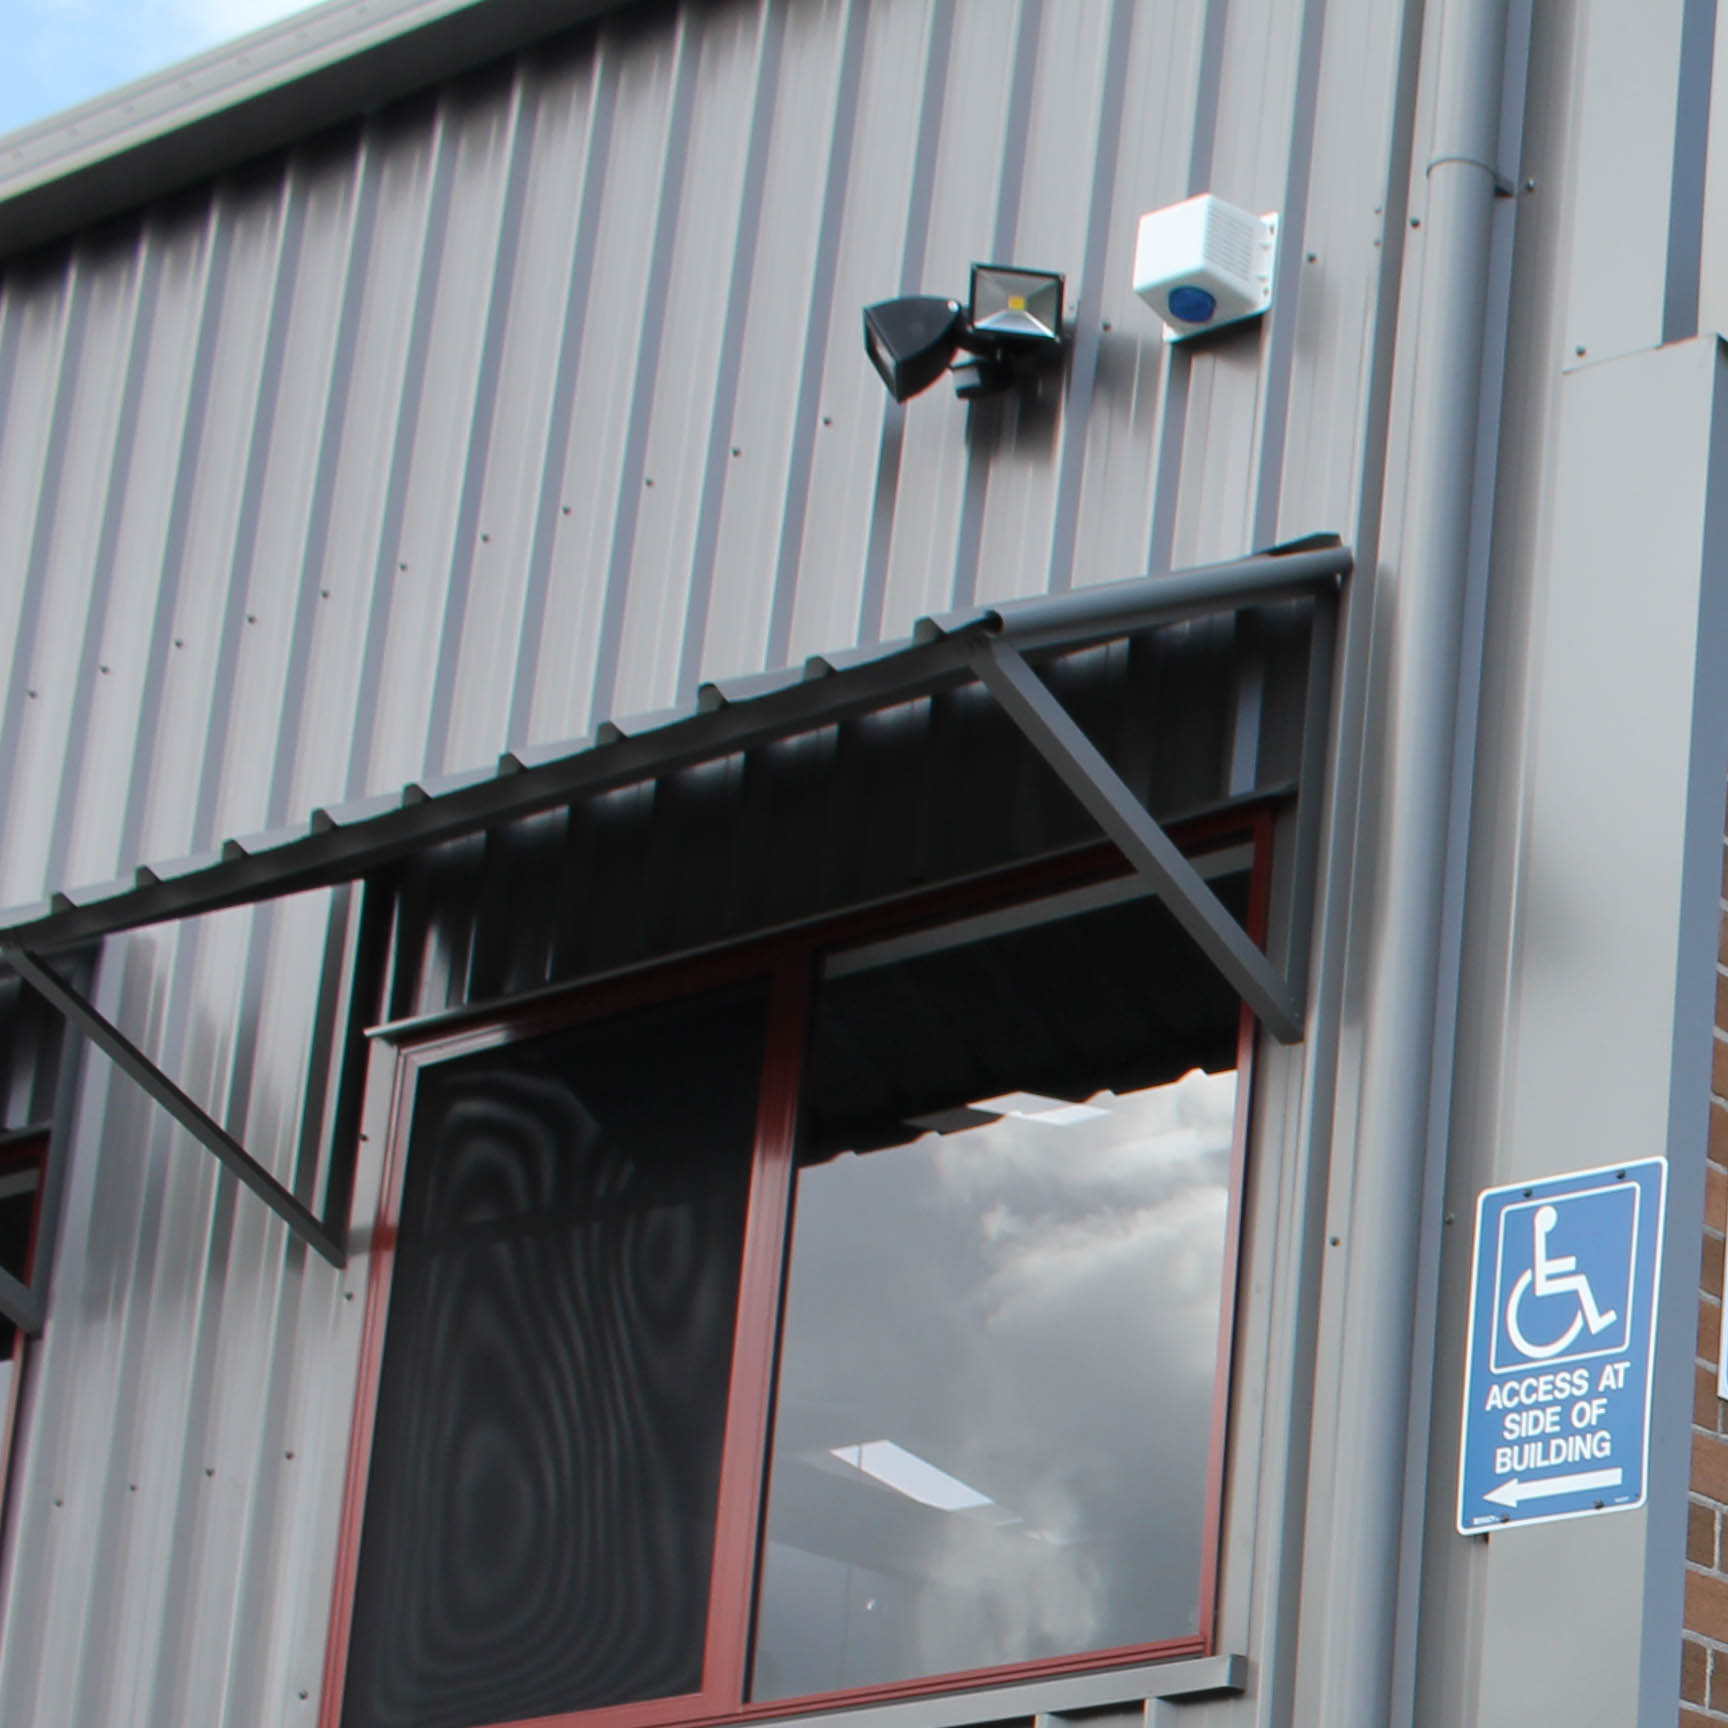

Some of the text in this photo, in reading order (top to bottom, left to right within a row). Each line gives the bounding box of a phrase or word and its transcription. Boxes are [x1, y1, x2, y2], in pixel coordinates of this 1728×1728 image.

[1485, 1361, 1631, 1411] ACCESS AT
[1502, 1398, 1608, 1440] SIDE OF
[1494, 1430, 1612, 1475] BUILDING
